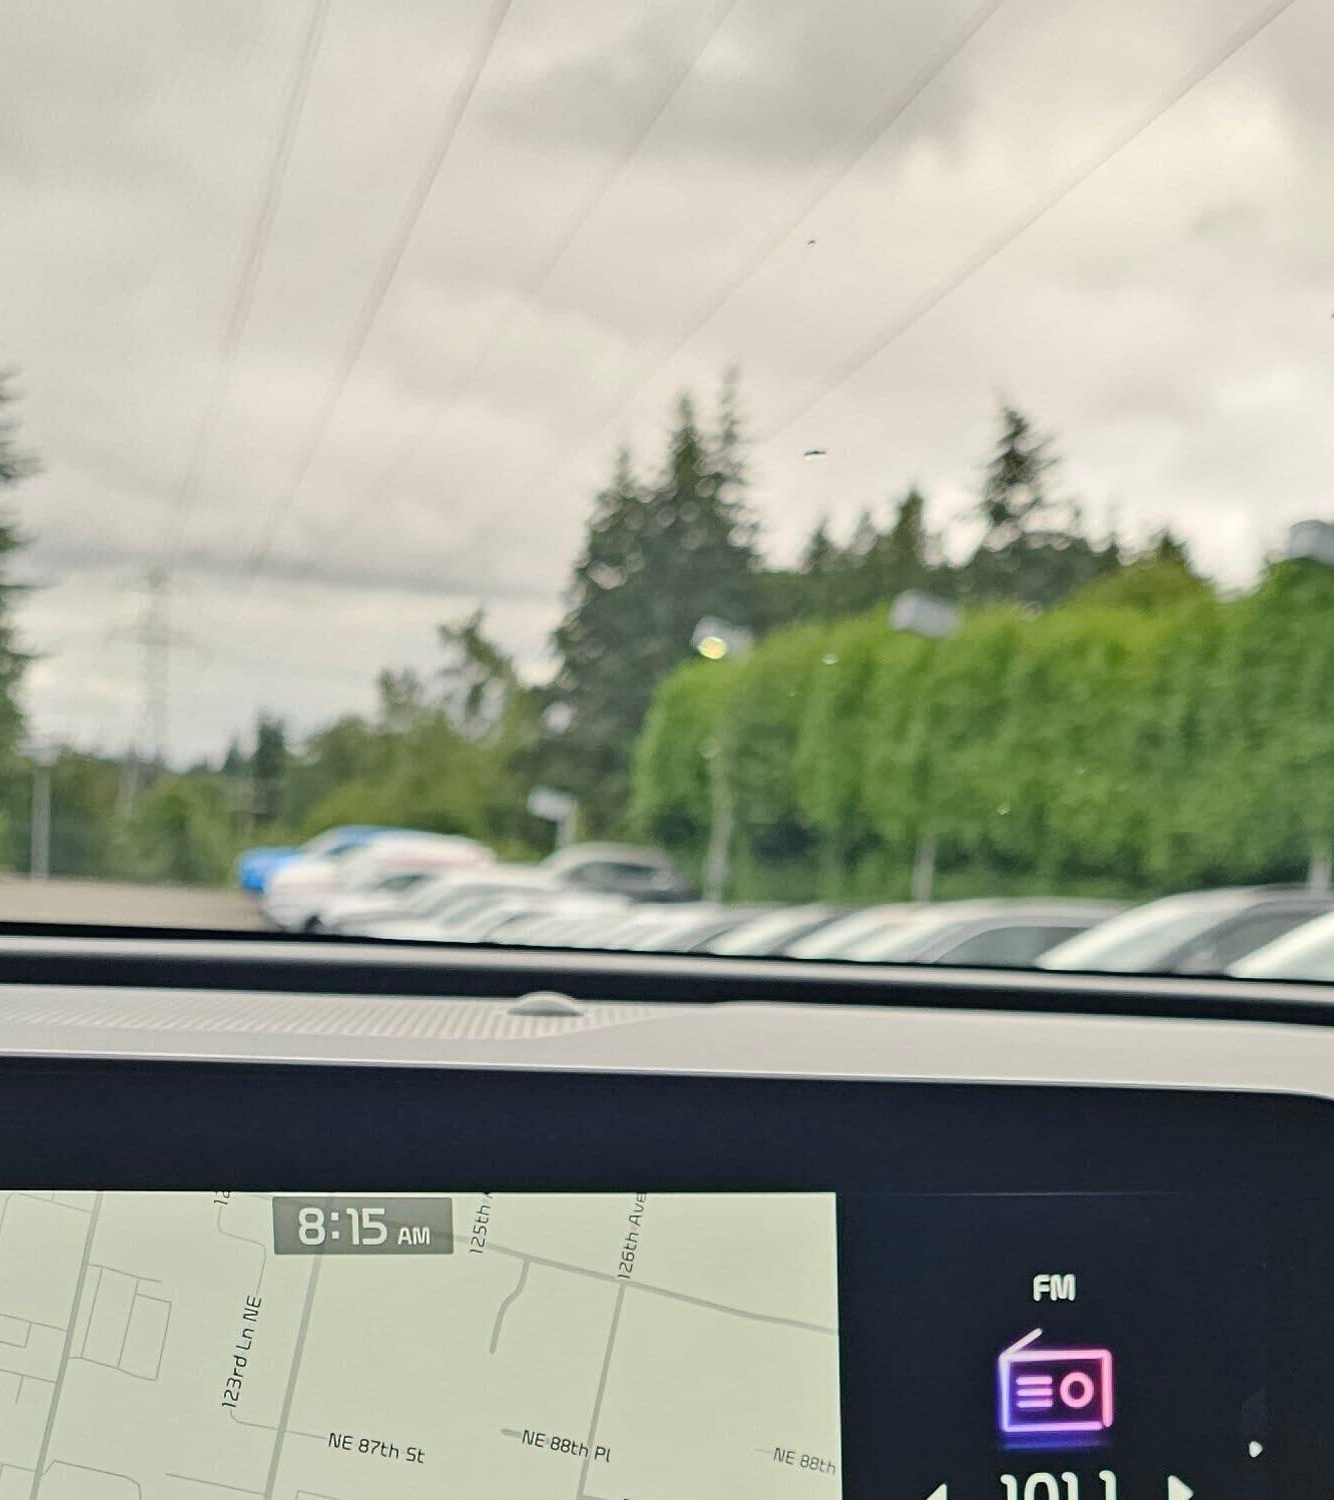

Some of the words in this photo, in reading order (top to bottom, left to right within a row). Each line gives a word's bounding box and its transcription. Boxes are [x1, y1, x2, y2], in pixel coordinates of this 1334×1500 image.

[297, 1207, 388, 1246] 8:15
[397, 1226, 431, 1246] AM
[469, 1204, 492, 1254] 125th
[617, 1232, 640, 1279] 126th
[1033, 1273, 1076, 1301] FM
[242, 1295, 262, 1322] NE
[235, 1328, 255, 1350] Ln
[221, 1354, 247, 1408] 123rd
[328, 1432, 354, 1451] NE
[358, 1439, 400, 1459] 87th
[405, 1447, 426, 1464] St
[521, 1429, 545, 1449] NE
[550, 1436, 589, 1459] 88th
[594, 1445, 611, 1463] Pl
[773, 1447, 796, 1465] NE
[800, 1454, 837, 1476] 88th
